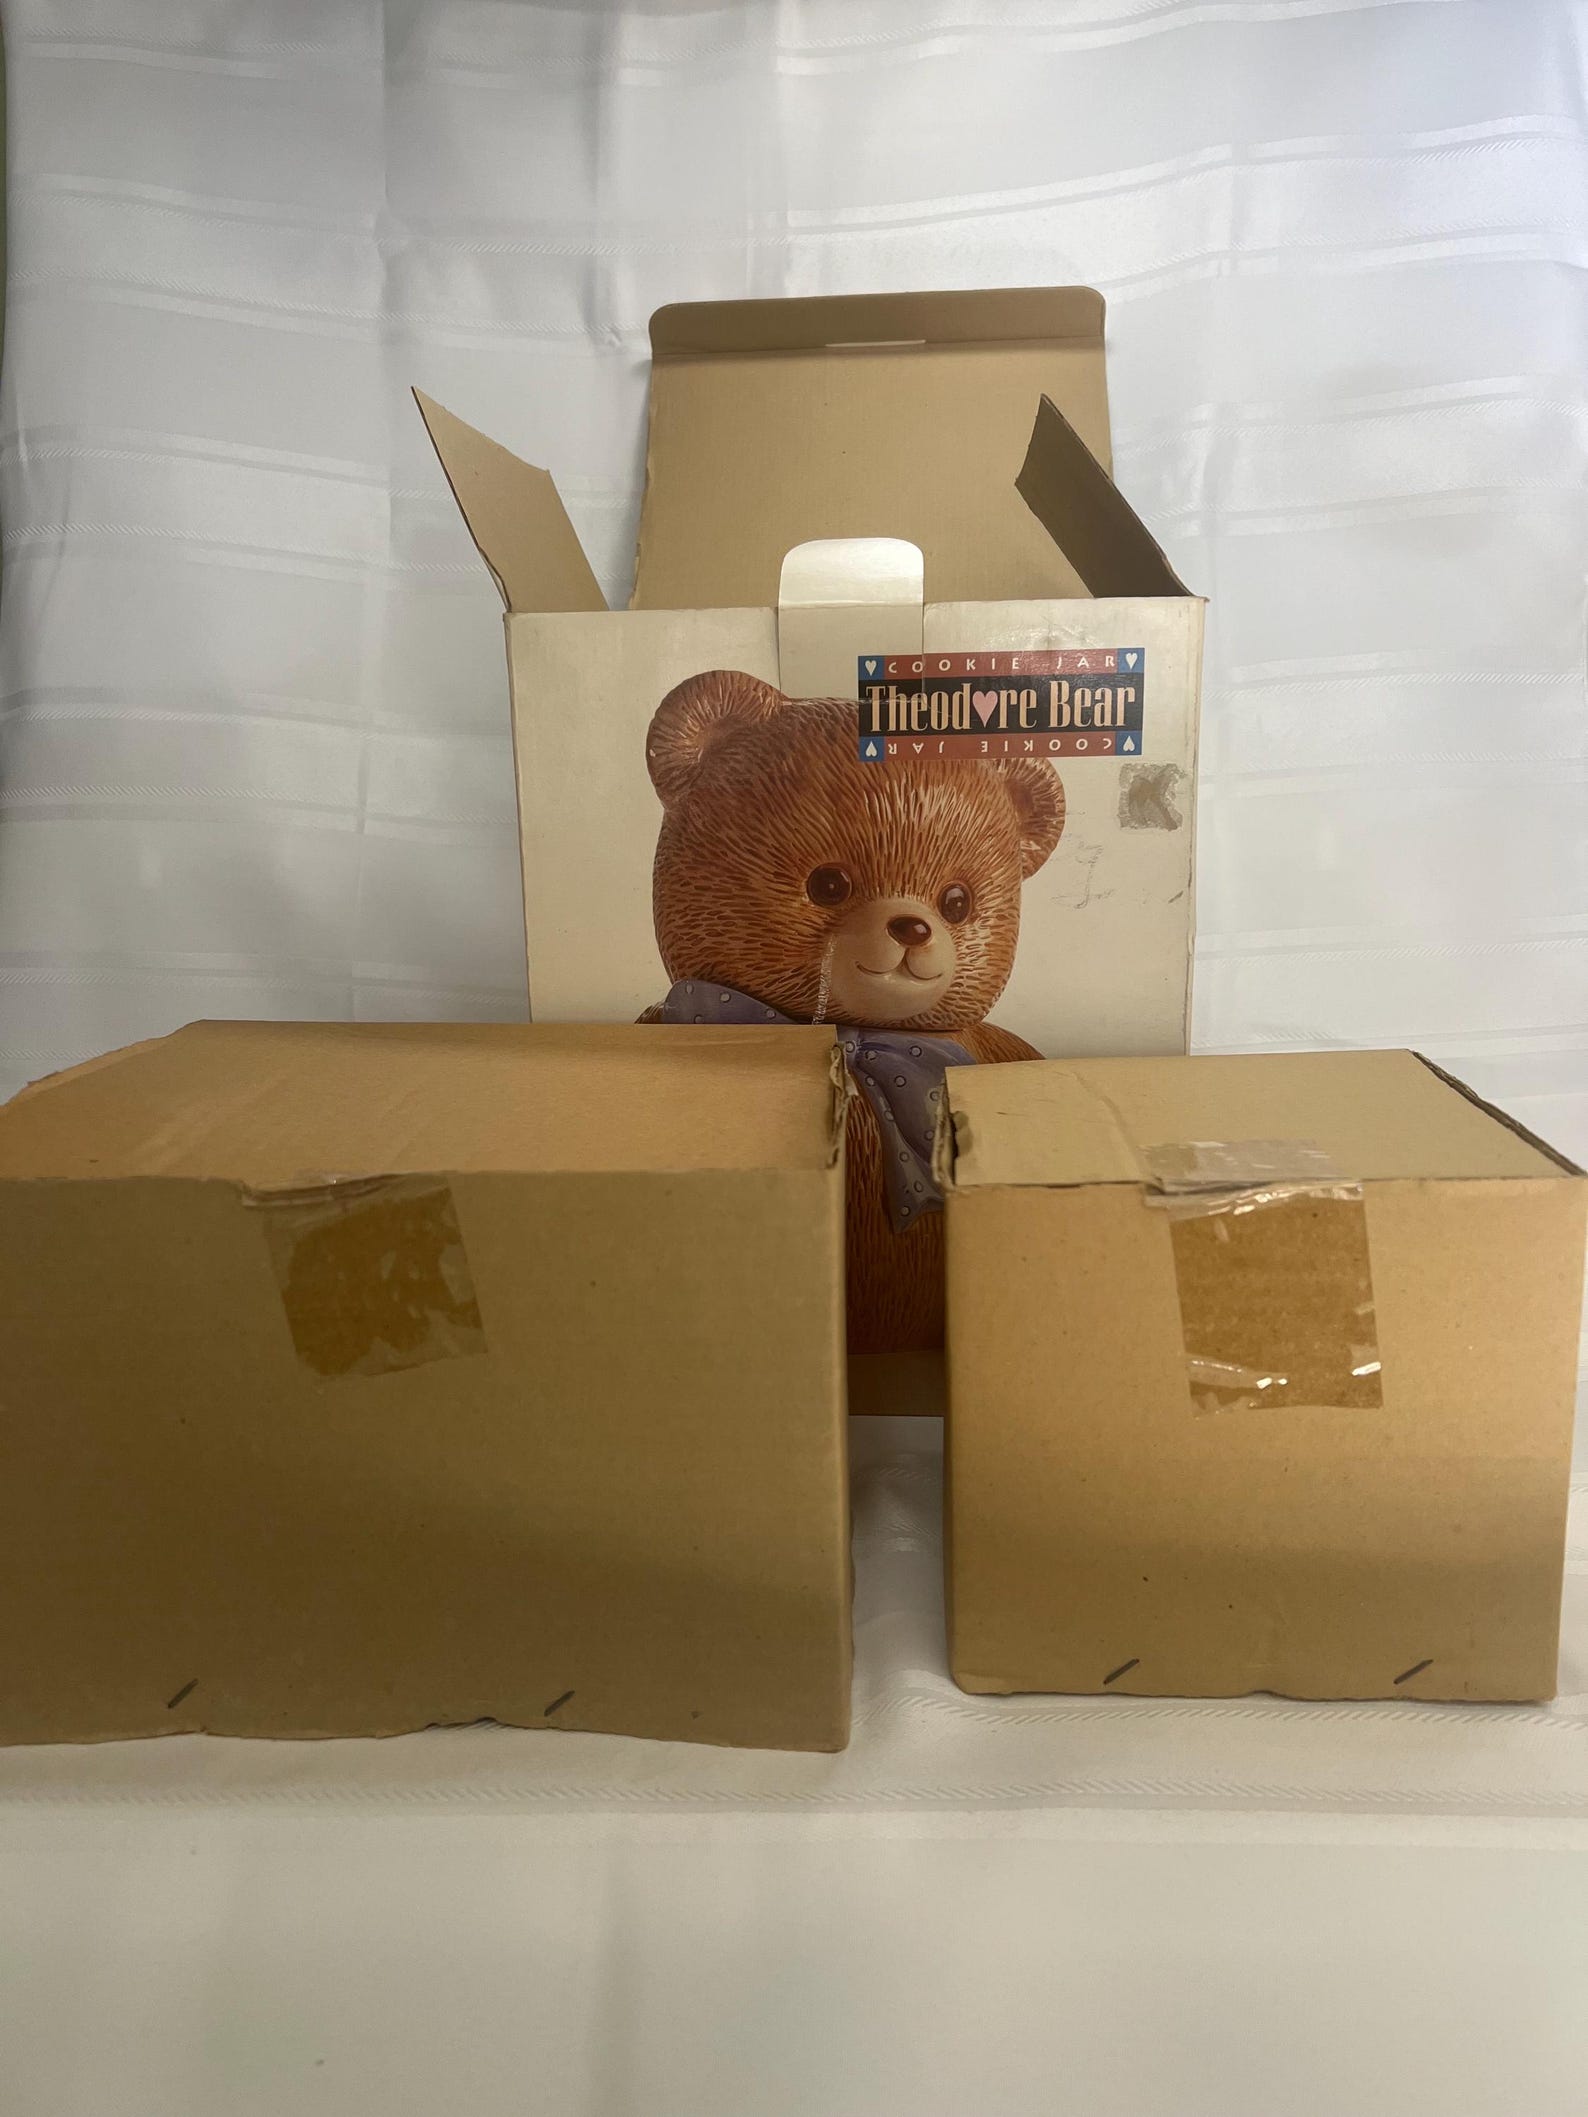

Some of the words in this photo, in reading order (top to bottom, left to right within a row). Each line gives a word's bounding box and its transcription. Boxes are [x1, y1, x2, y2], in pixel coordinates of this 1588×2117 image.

[888, 657, 1020, 674] COOKIE
[1056, 655, 1116, 669] JAR
[1047, 680, 1136, 729] Bear
[887, 740, 944, 755] JAR
[980, 737, 1113, 753] COOKIE
